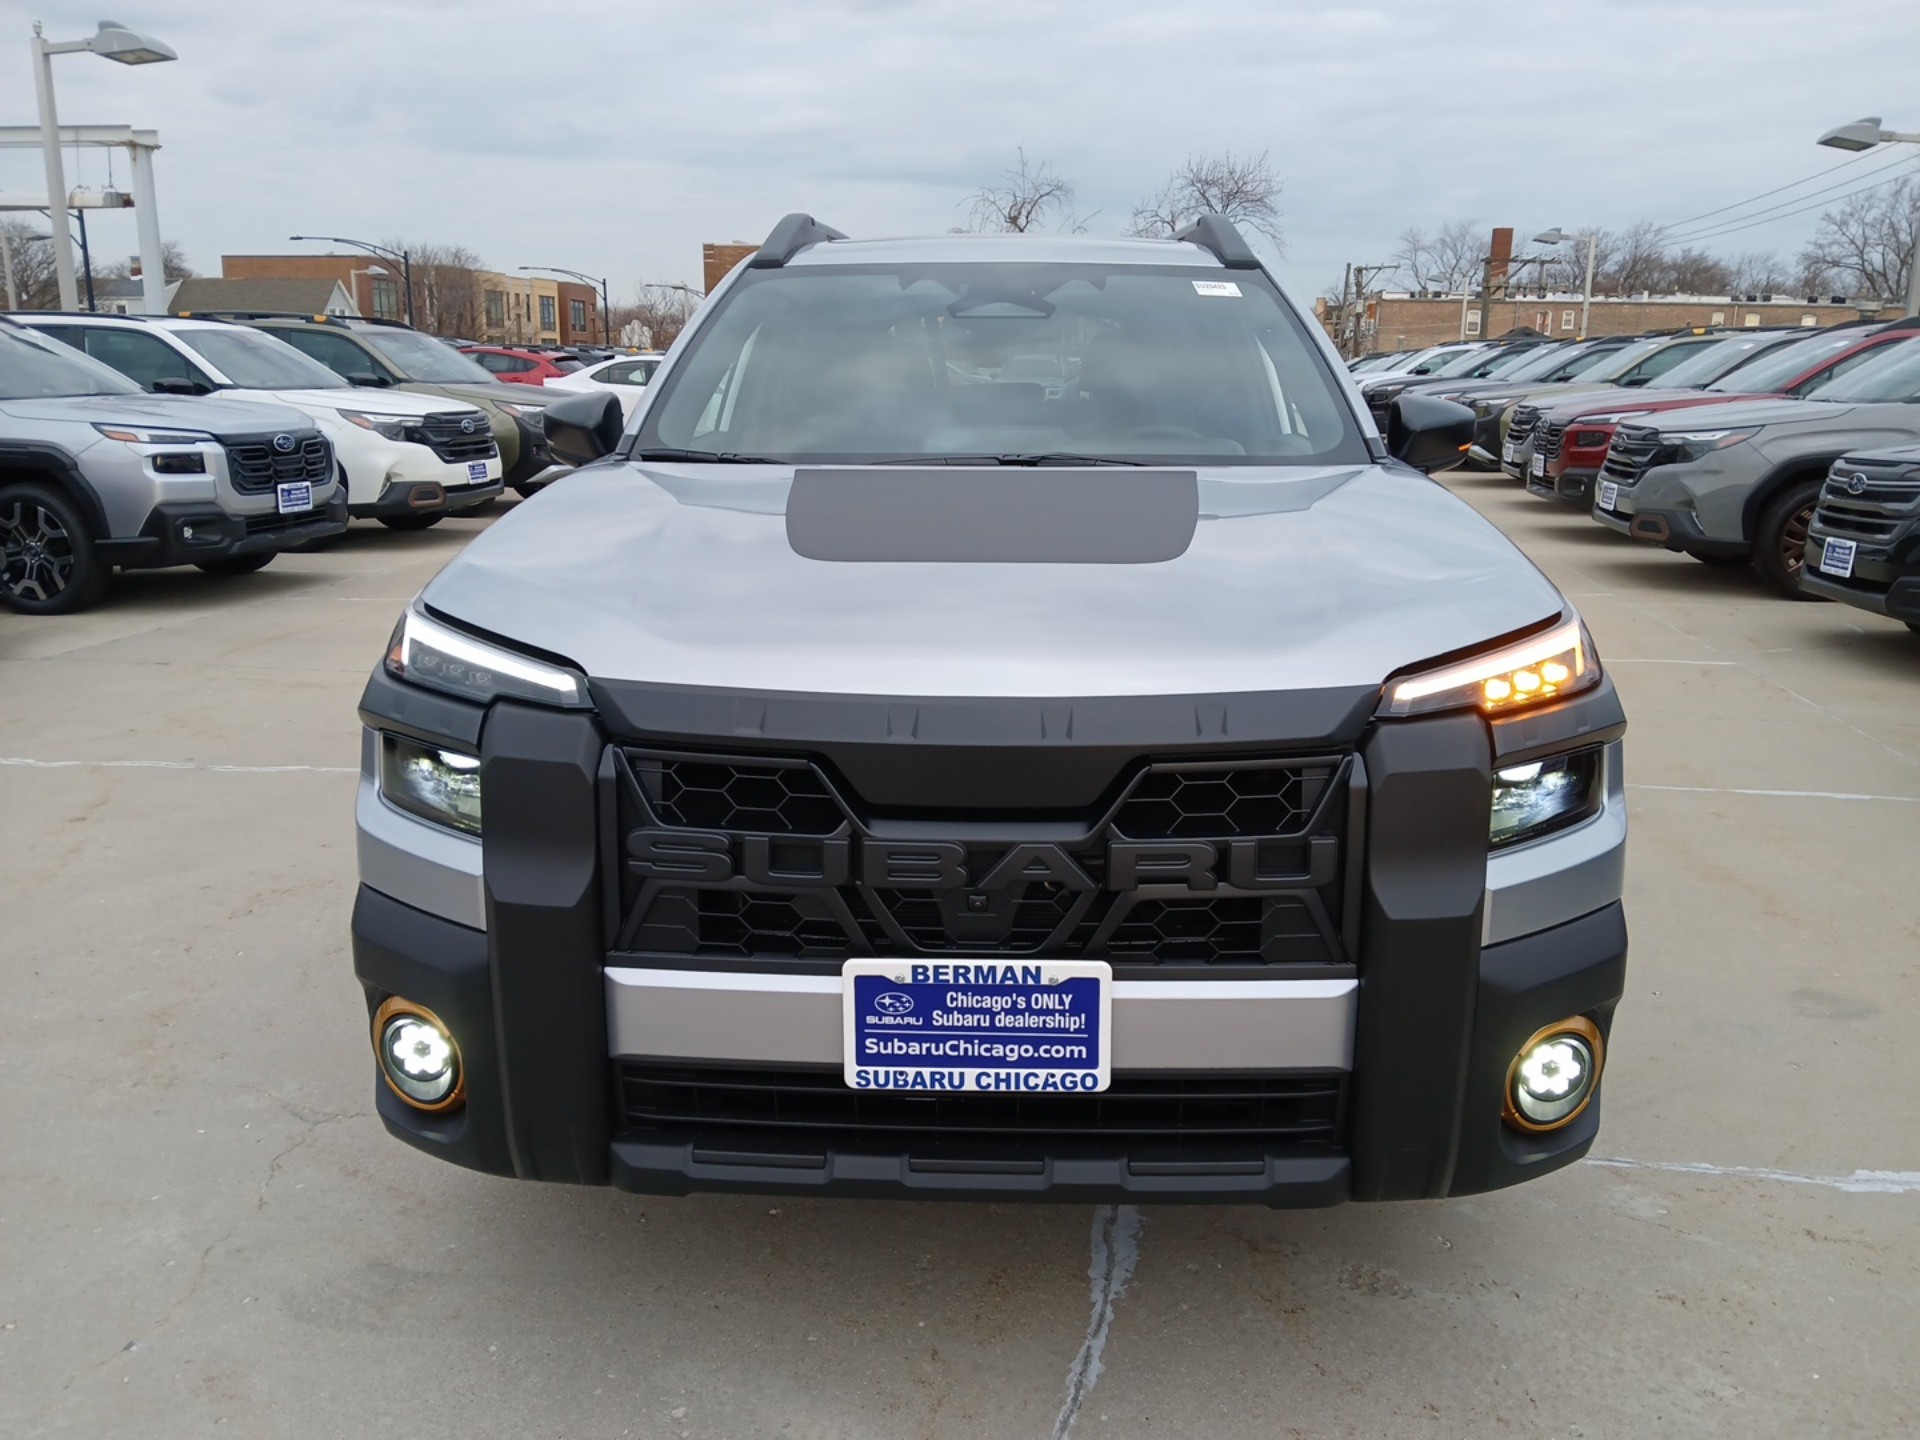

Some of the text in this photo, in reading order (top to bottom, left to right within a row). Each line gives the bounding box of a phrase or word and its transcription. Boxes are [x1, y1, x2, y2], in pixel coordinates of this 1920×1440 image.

[627, 831, 1338, 891] SUBARU
[911, 964, 1042, 985] BERMAN
[946, 991, 1073, 1010] Chicago's ONLY
[865, 1015, 924, 1025] SUBARU
[932, 1011, 1086, 1032] Subaru dealership!
[864, 1038, 1088, 1061] SubaruChicago.com
[855, 1070, 1098, 1091] SUBARU CHICAGO
